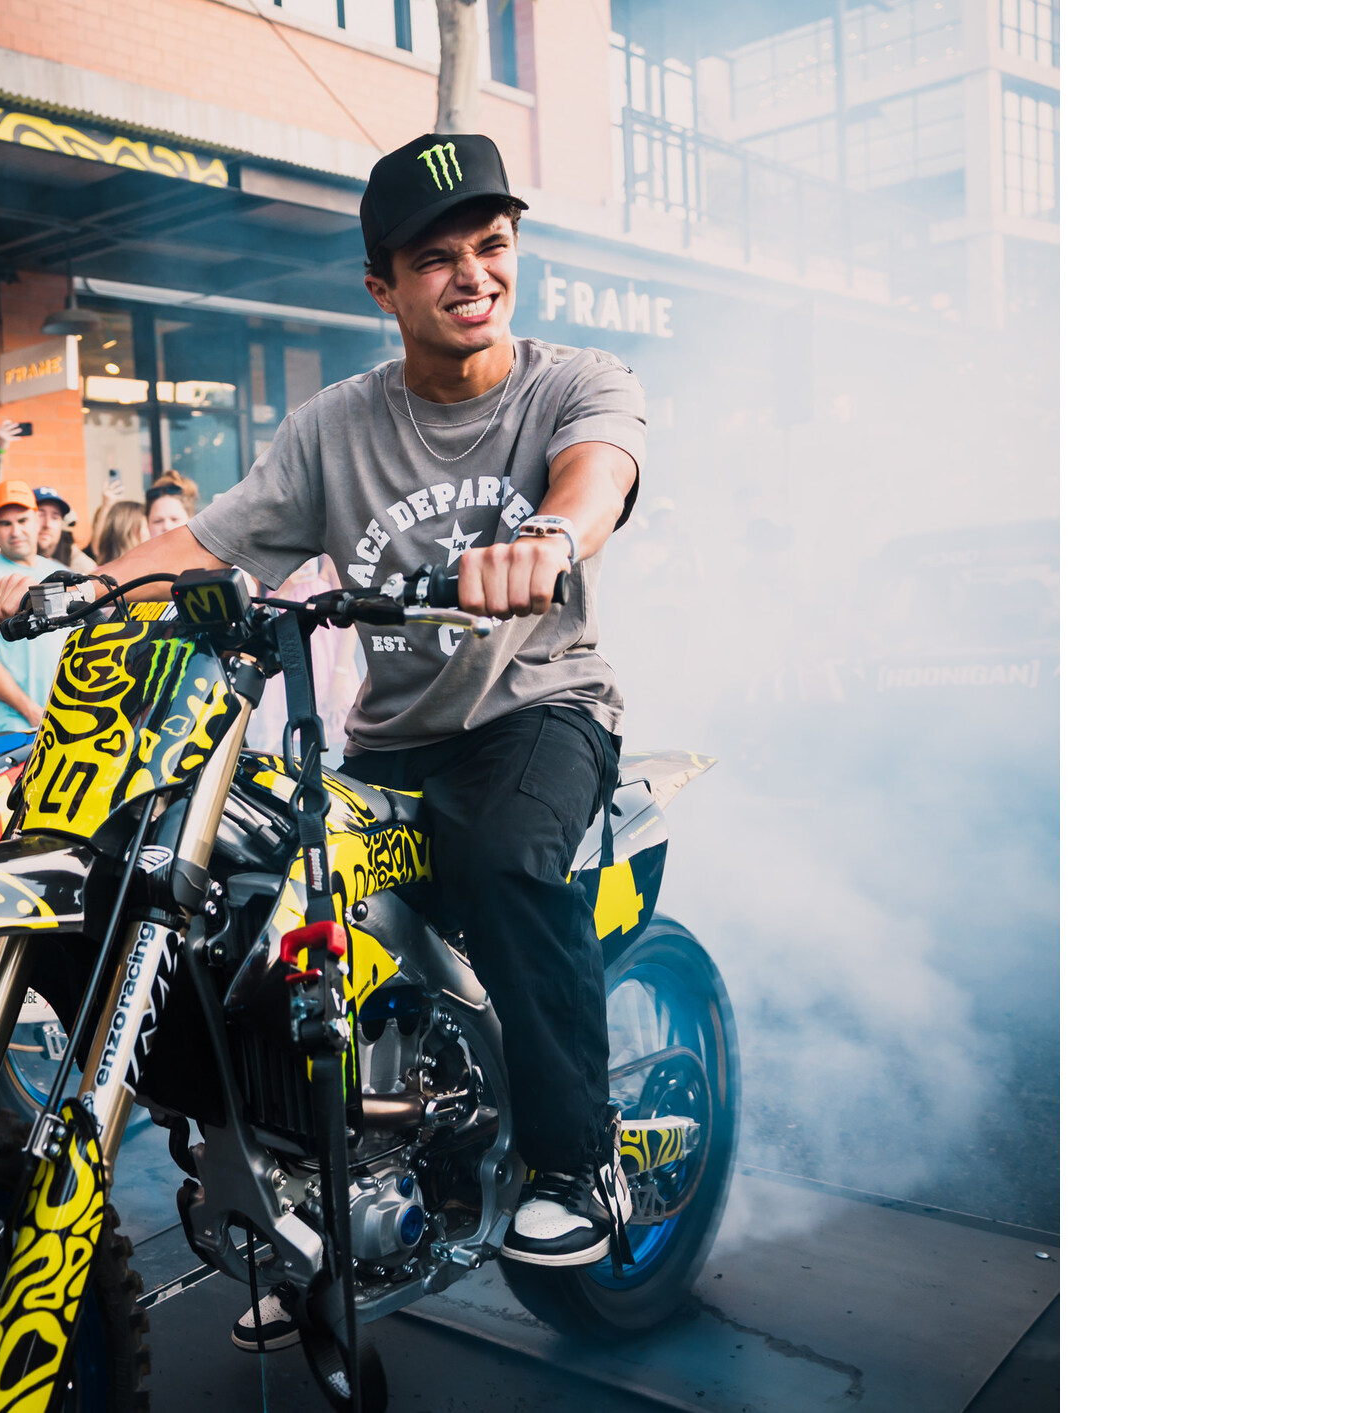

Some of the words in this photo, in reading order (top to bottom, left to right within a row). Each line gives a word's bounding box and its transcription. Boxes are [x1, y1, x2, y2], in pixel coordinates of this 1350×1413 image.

[542, 277, 674, 338] FRAME
[5, 356, 62, 385] FRAME
[347, 518, 391, 588] ACE
[371, 636, 413, 652] EST.
[95, 921, 157, 1087] enzoracing
